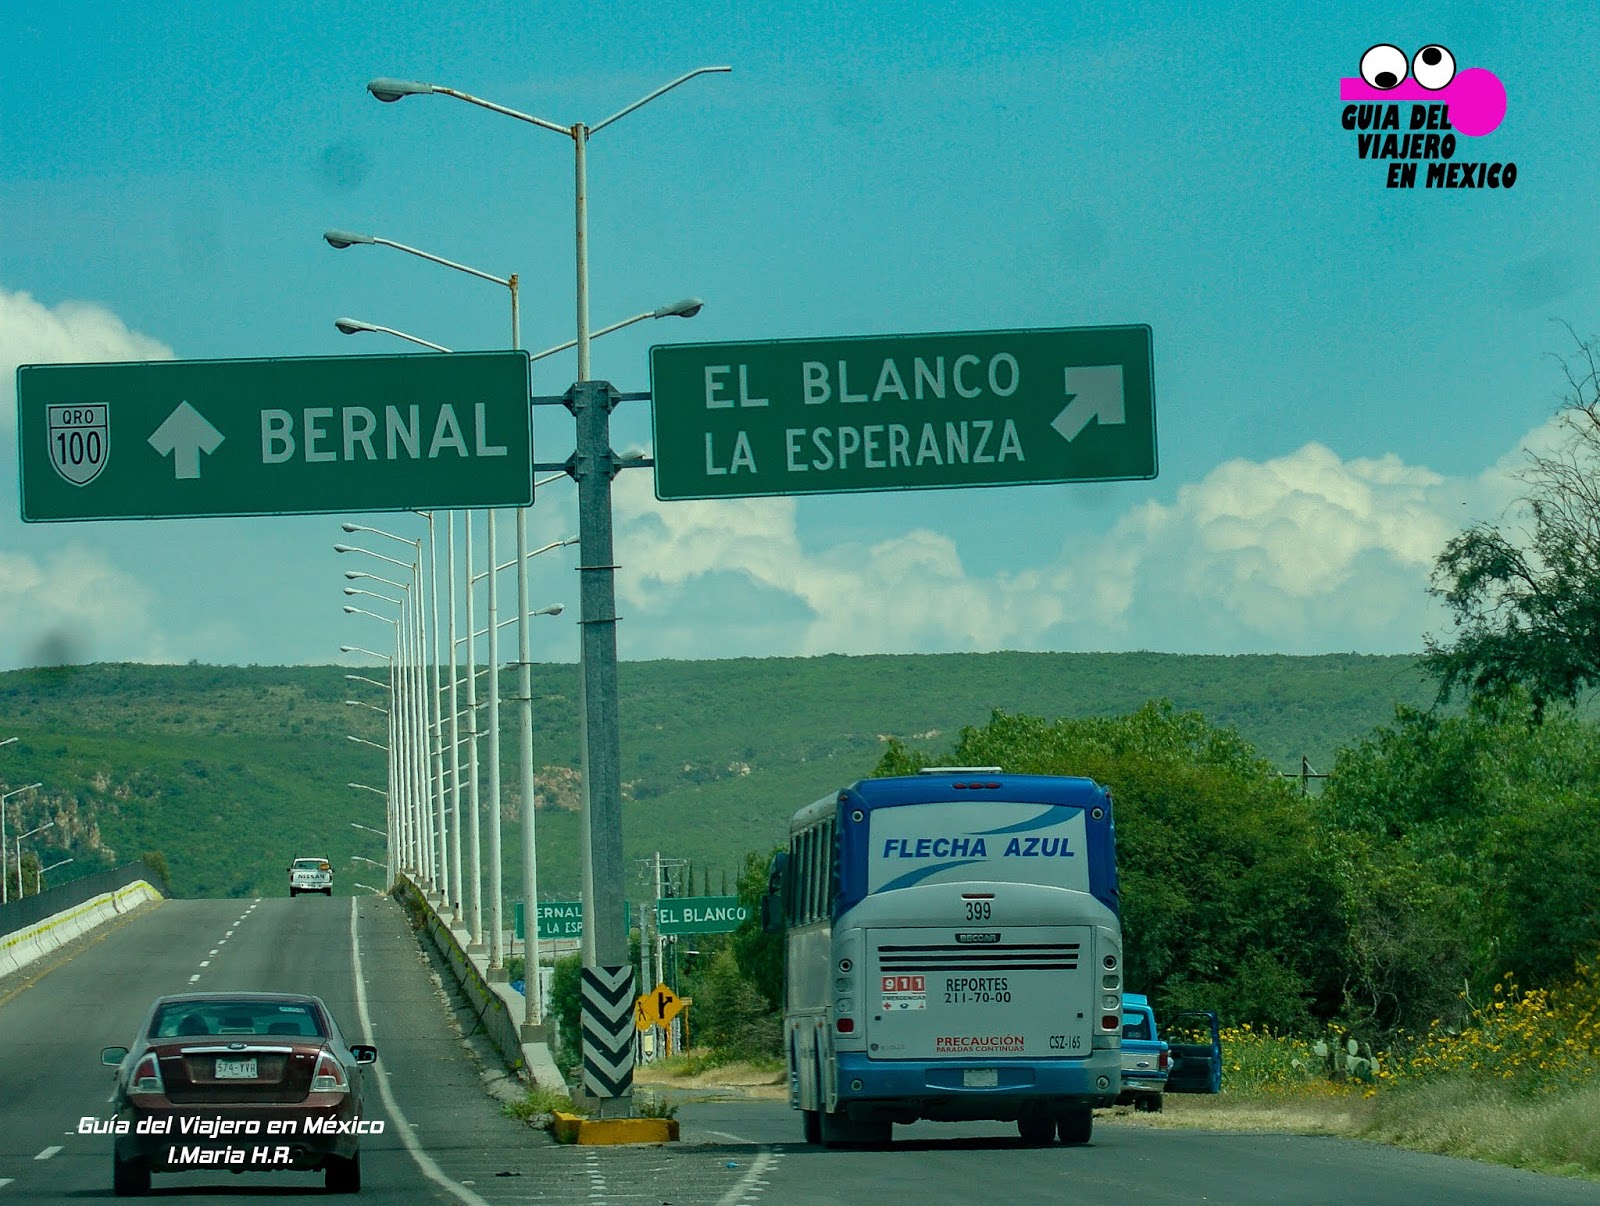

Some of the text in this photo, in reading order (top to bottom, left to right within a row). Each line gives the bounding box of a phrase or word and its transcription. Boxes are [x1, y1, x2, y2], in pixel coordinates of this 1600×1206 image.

[704, 352, 1020, 409] EL BLANCO
[62, 409, 94, 425] QRO
[260, 402, 508, 464] BERNAL
[57, 430, 101, 465] 100
[704, 418, 1026, 475] LA ESPERANZA
[883, 837, 1075, 859] FLECHA AZUL
[536, 907, 582, 919] ERNAL
[660, 907, 747, 924] EL BLANCO
[965, 902, 991, 921] 399
[546, 923, 560, 934] LA
[884, 978, 924, 990] 911
[946, 977, 1008, 992] REPORTES
[944, 992, 1011, 1003] 211-70-00
[936, 1034, 1024, 1046] PRECAUCIÓN
[1049, 1035, 1081, 1049] CSZ-165
